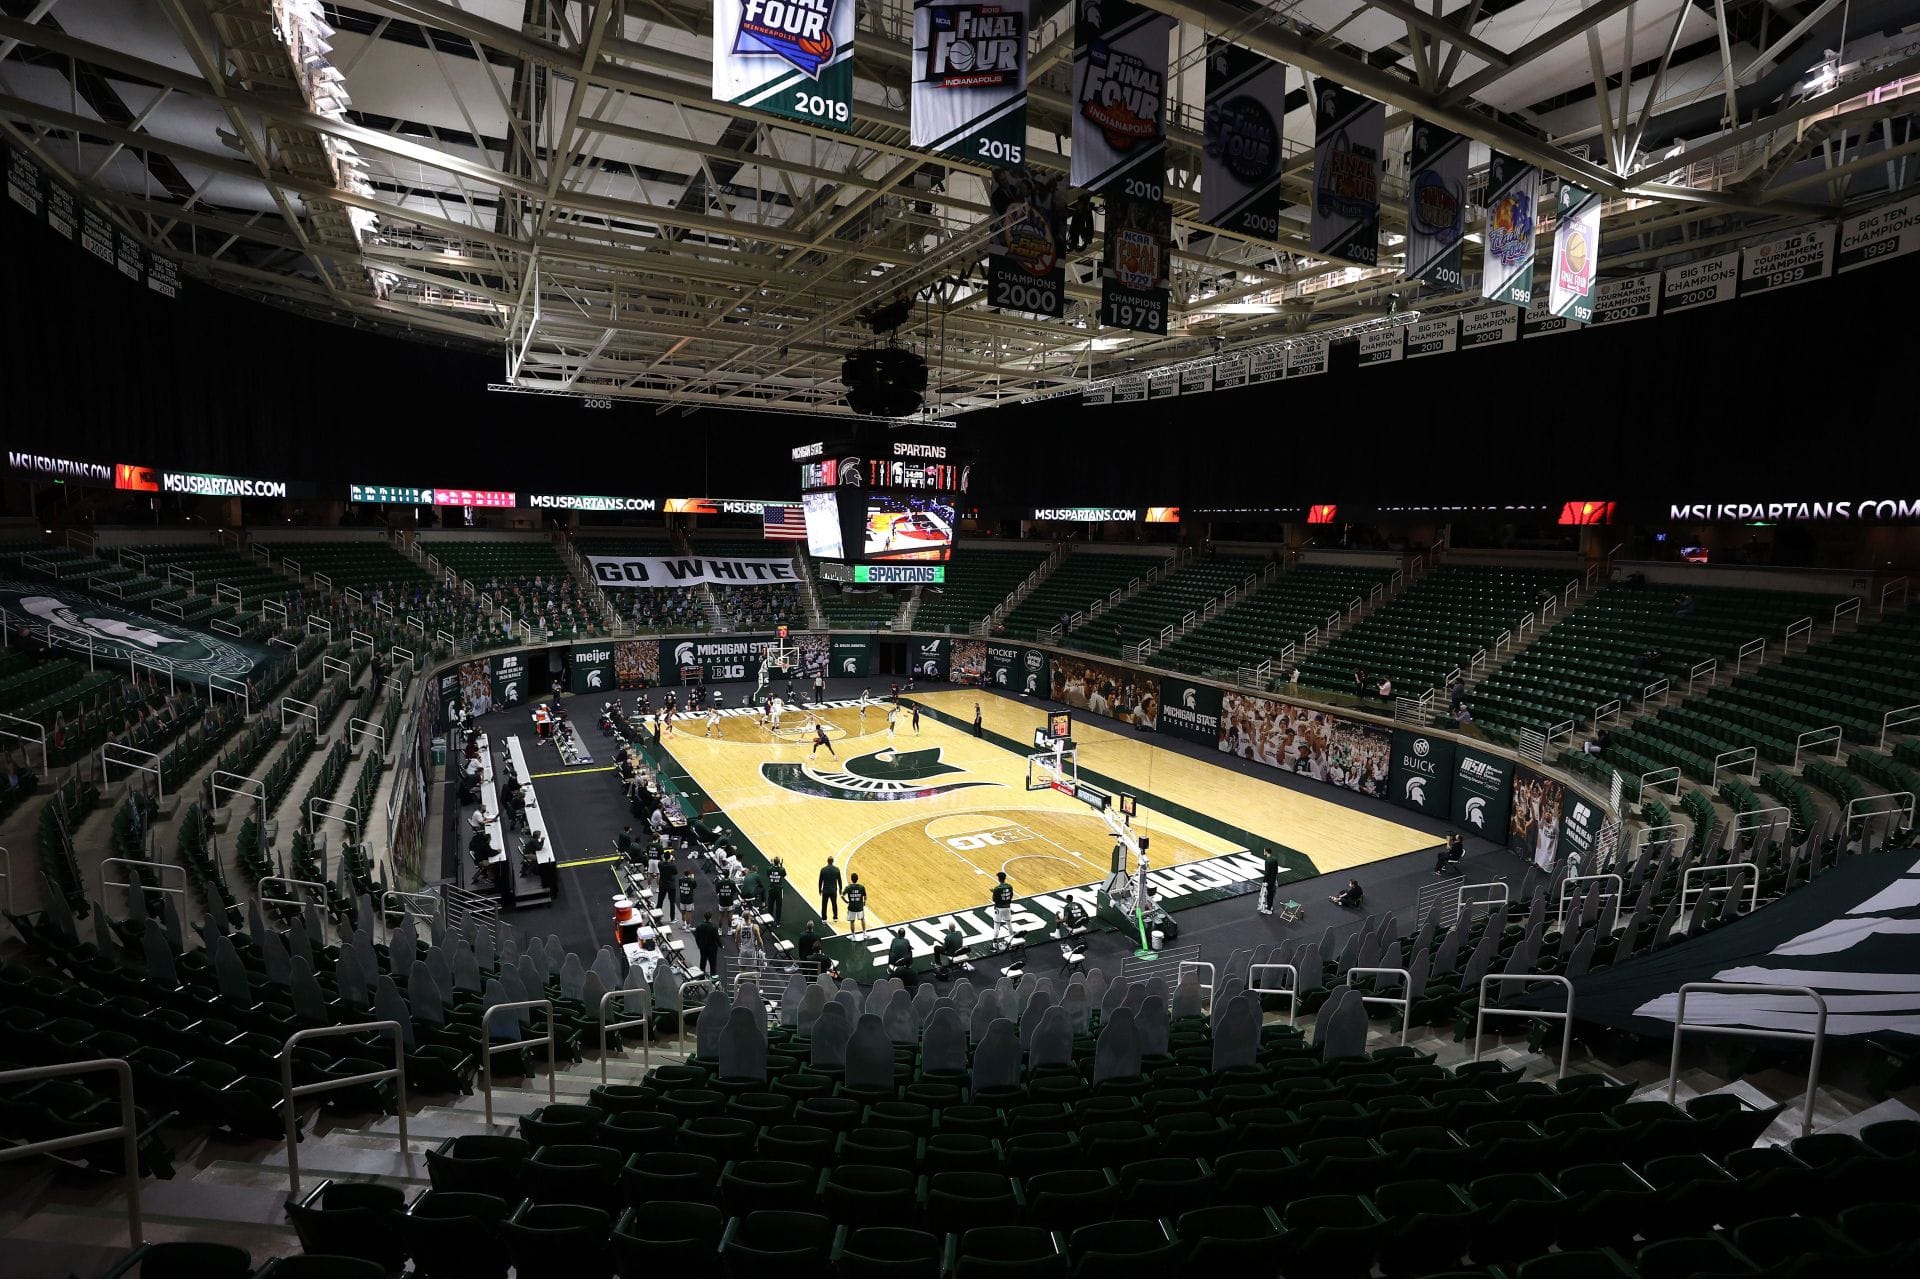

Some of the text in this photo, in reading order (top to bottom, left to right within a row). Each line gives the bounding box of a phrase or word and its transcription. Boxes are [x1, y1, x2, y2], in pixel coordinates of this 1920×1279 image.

[745, 0, 825, 41] FOUR
[957, 11, 1017, 38] FINAL
[743, 22, 797, 41] MINNEAPOLIS
[934, 31, 1019, 73] FOUR
[1122, 56, 1143, 67] 2010
[945, 76, 1002, 86] INDIANAPOLIS
[1106, 53, 1160, 95] FINAL
[1083, 65, 1159, 123] FOUR
[794, 93, 849, 122] 2019
[1089, 105, 1152, 133] INDIANAPOLIS
[978, 138, 1022, 164] 2015
[1218, 122, 1272, 163] FOUR
[1124, 178, 1162, 202] 2010
[1243, 212, 1277, 234] 2009
[1859, 207, 1908, 231] BIG TEN
[1125, 232, 1150, 244] NCAA
[1843, 214, 1920, 248] CHAMPIONS
[1347, 243, 1376, 261] 2005
[1754, 241, 1824, 266] TOURNAMENT
[1863, 239, 1896, 259] 1999
[1680, 261, 1722, 279] BIG TEN
[1752, 250, 1824, 275] CHAMPIONS
[997, 270, 1057, 290] CHAMPIONS
[1124, 273, 1149, 285] 1979
[1436, 267, 1460, 285] 2001
[1667, 269, 1736, 292] CHAMPIONS
[1766, 267, 1805, 287] 1999
[996, 282, 1057, 312] 2000
[1109, 292, 1161, 310] CHAMPIONS
[1511, 288, 1530, 302] 1999
[1595, 294, 1651, 310] CHAMPIONS
[1597, 286, 1652, 302] TOURNAMENT
[1680, 288, 1714, 305] 2000
[1110, 303, 1160, 330] 1979
[1474, 309, 1507, 321] BIG TEN
[1574, 306, 1592, 319] 1957
[1603, 306, 1638, 322] 2000
[1419, 321, 1448, 333] BIG TEN
[1465, 316, 1516, 332] CHAMPIONS
[1541, 319, 1565, 330] 2001
[1361, 337, 1403, 351] CHAMPIONS
[1368, 331, 1395, 343] BIG TEN
[1410, 328, 1456, 342] CHAMPIONS
[1476, 331, 1501, 342] 2009
[1372, 350, 1391, 360] 2012
[1421, 341, 1442, 352] 2010
[1292, 356, 1325, 366] CHAMPIONS
[1298, 365, 1316, 375] 2012
[584, 399, 612, 409] 2005
[893, 443, 947, 458] SPARTANS
[9, 451, 111, 480] MSUSPARTANSCOM
[164, 474, 286, 497] MSUSPARTANS.COM
[530, 494, 655, 512] MSUSPARTANS.COM
[1035, 508, 1136, 522] MSUSPARTANS.COM
[595, 559, 790, 581] GO WHITE
[868, 567, 935, 581] SPARTANS
[576, 649, 610, 664] meijer
[697, 642, 747, 656] MICHIGAN
[988, 647, 1018, 659] ROCKET
[697, 655, 771, 664] BASKETBA
[1163, 704, 1218, 728] MICHIGAN STATE
[1163, 716, 1216, 736] BASKETBALL
[1403, 755, 1435, 773] BUICK
